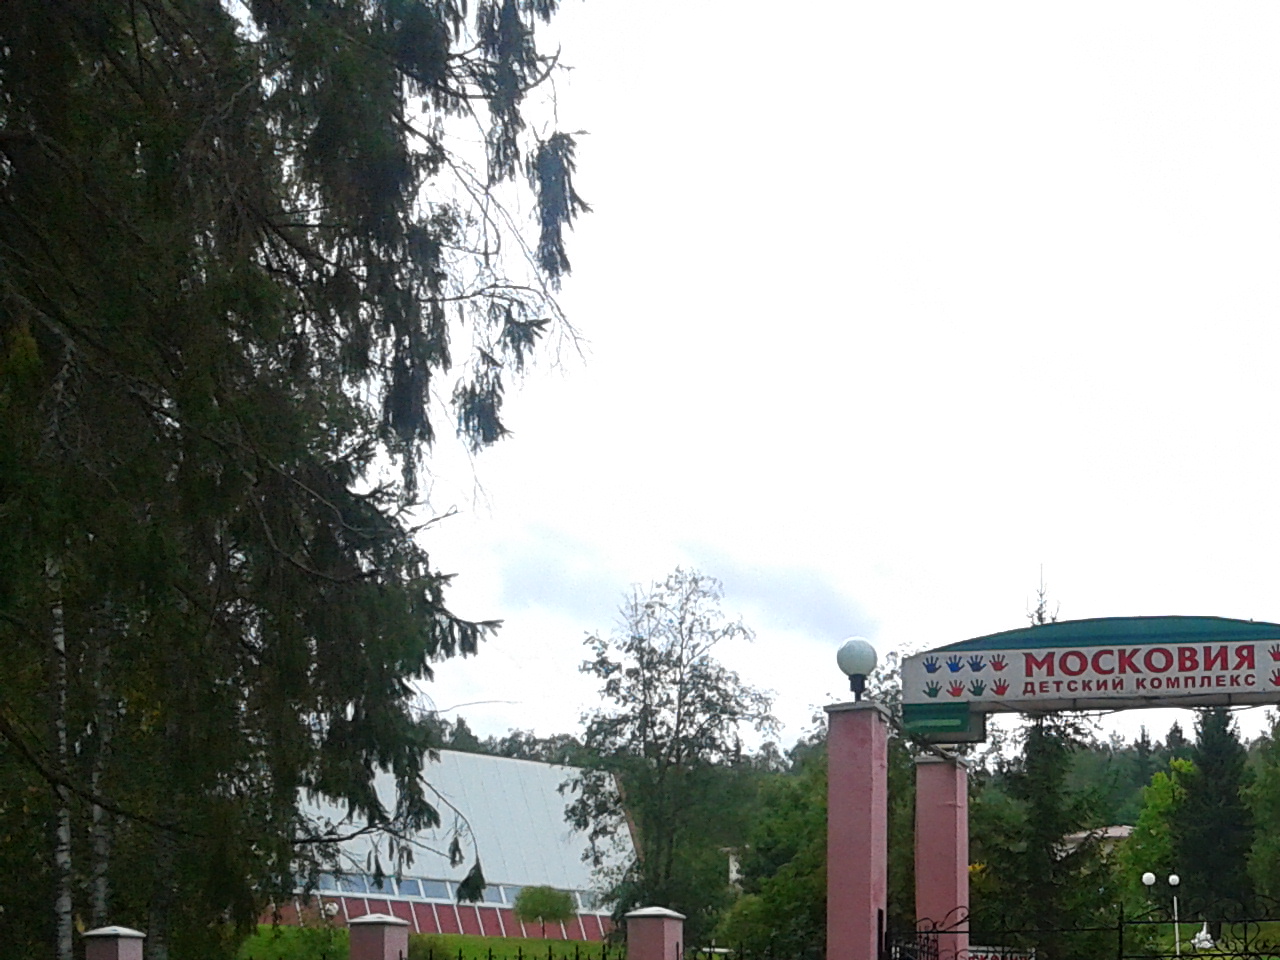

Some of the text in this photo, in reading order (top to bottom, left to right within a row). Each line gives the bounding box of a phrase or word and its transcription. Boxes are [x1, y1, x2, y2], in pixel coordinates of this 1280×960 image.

[1022, 645, 1256, 677] МОСКОВИЯ
[1023, 674, 1256, 696] ДЕТСКИЙ КОМПЛЕКС
